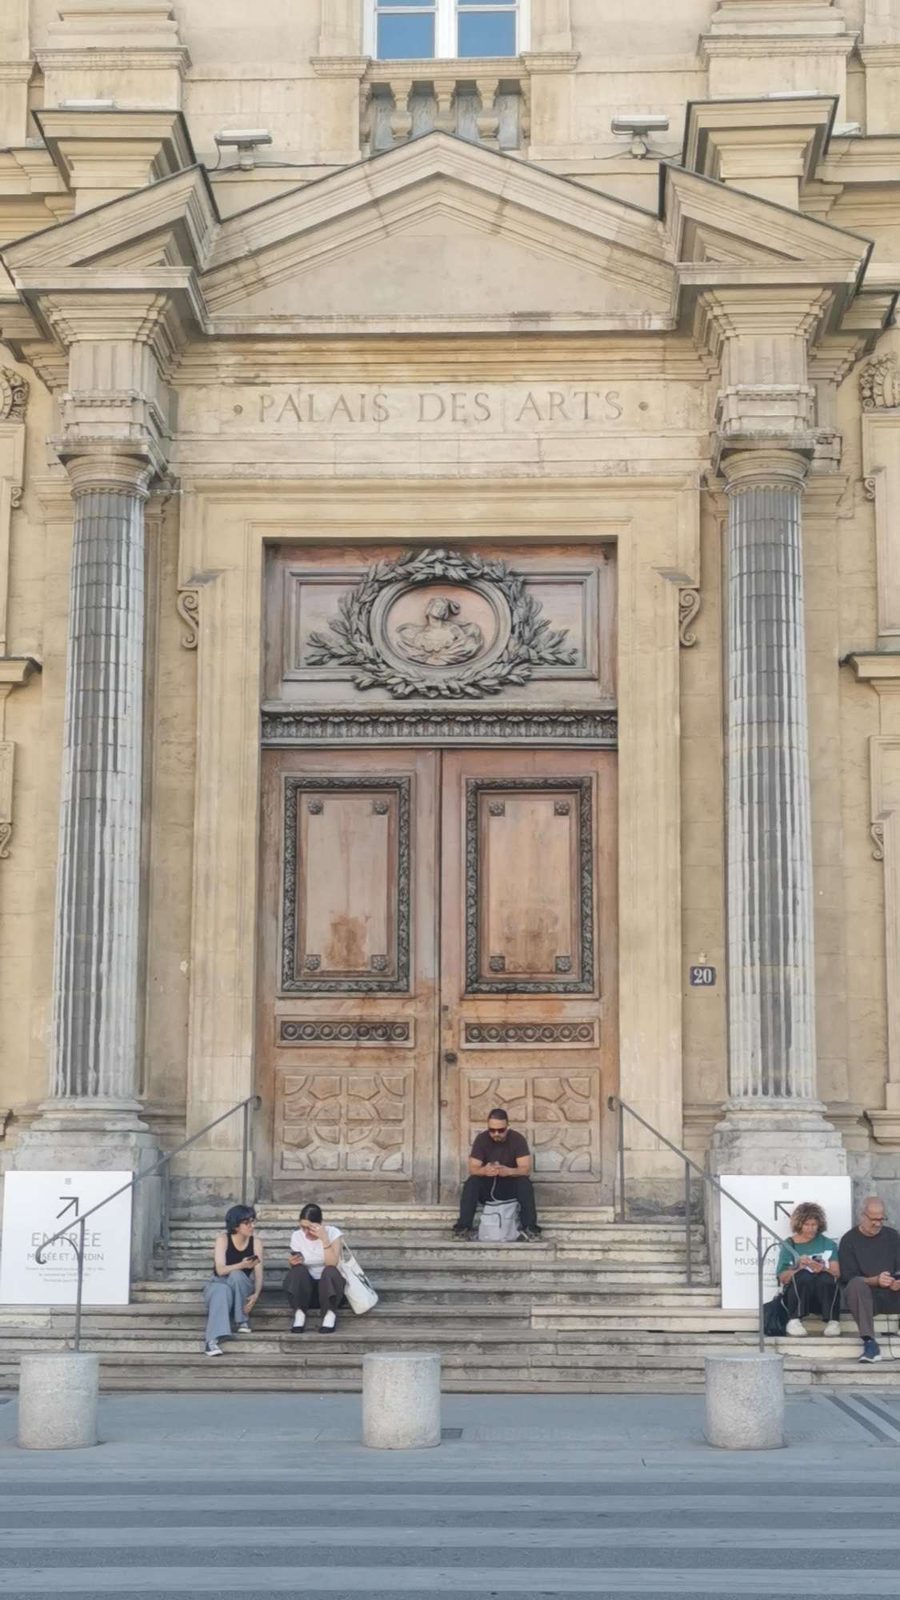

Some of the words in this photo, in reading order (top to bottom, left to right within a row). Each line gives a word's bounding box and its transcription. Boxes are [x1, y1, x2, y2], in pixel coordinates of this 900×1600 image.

[258, 392, 391, 423] PALAIS
[416, 391, 491, 423] DES
[515, 390, 624, 422] ARTS
[693, 968, 713, 984] 20
[27, 1252, 57, 1261] MSÉE
[59, 1252, 71, 1261] ET
[71, 1252, 105, 1261] JRDIN
